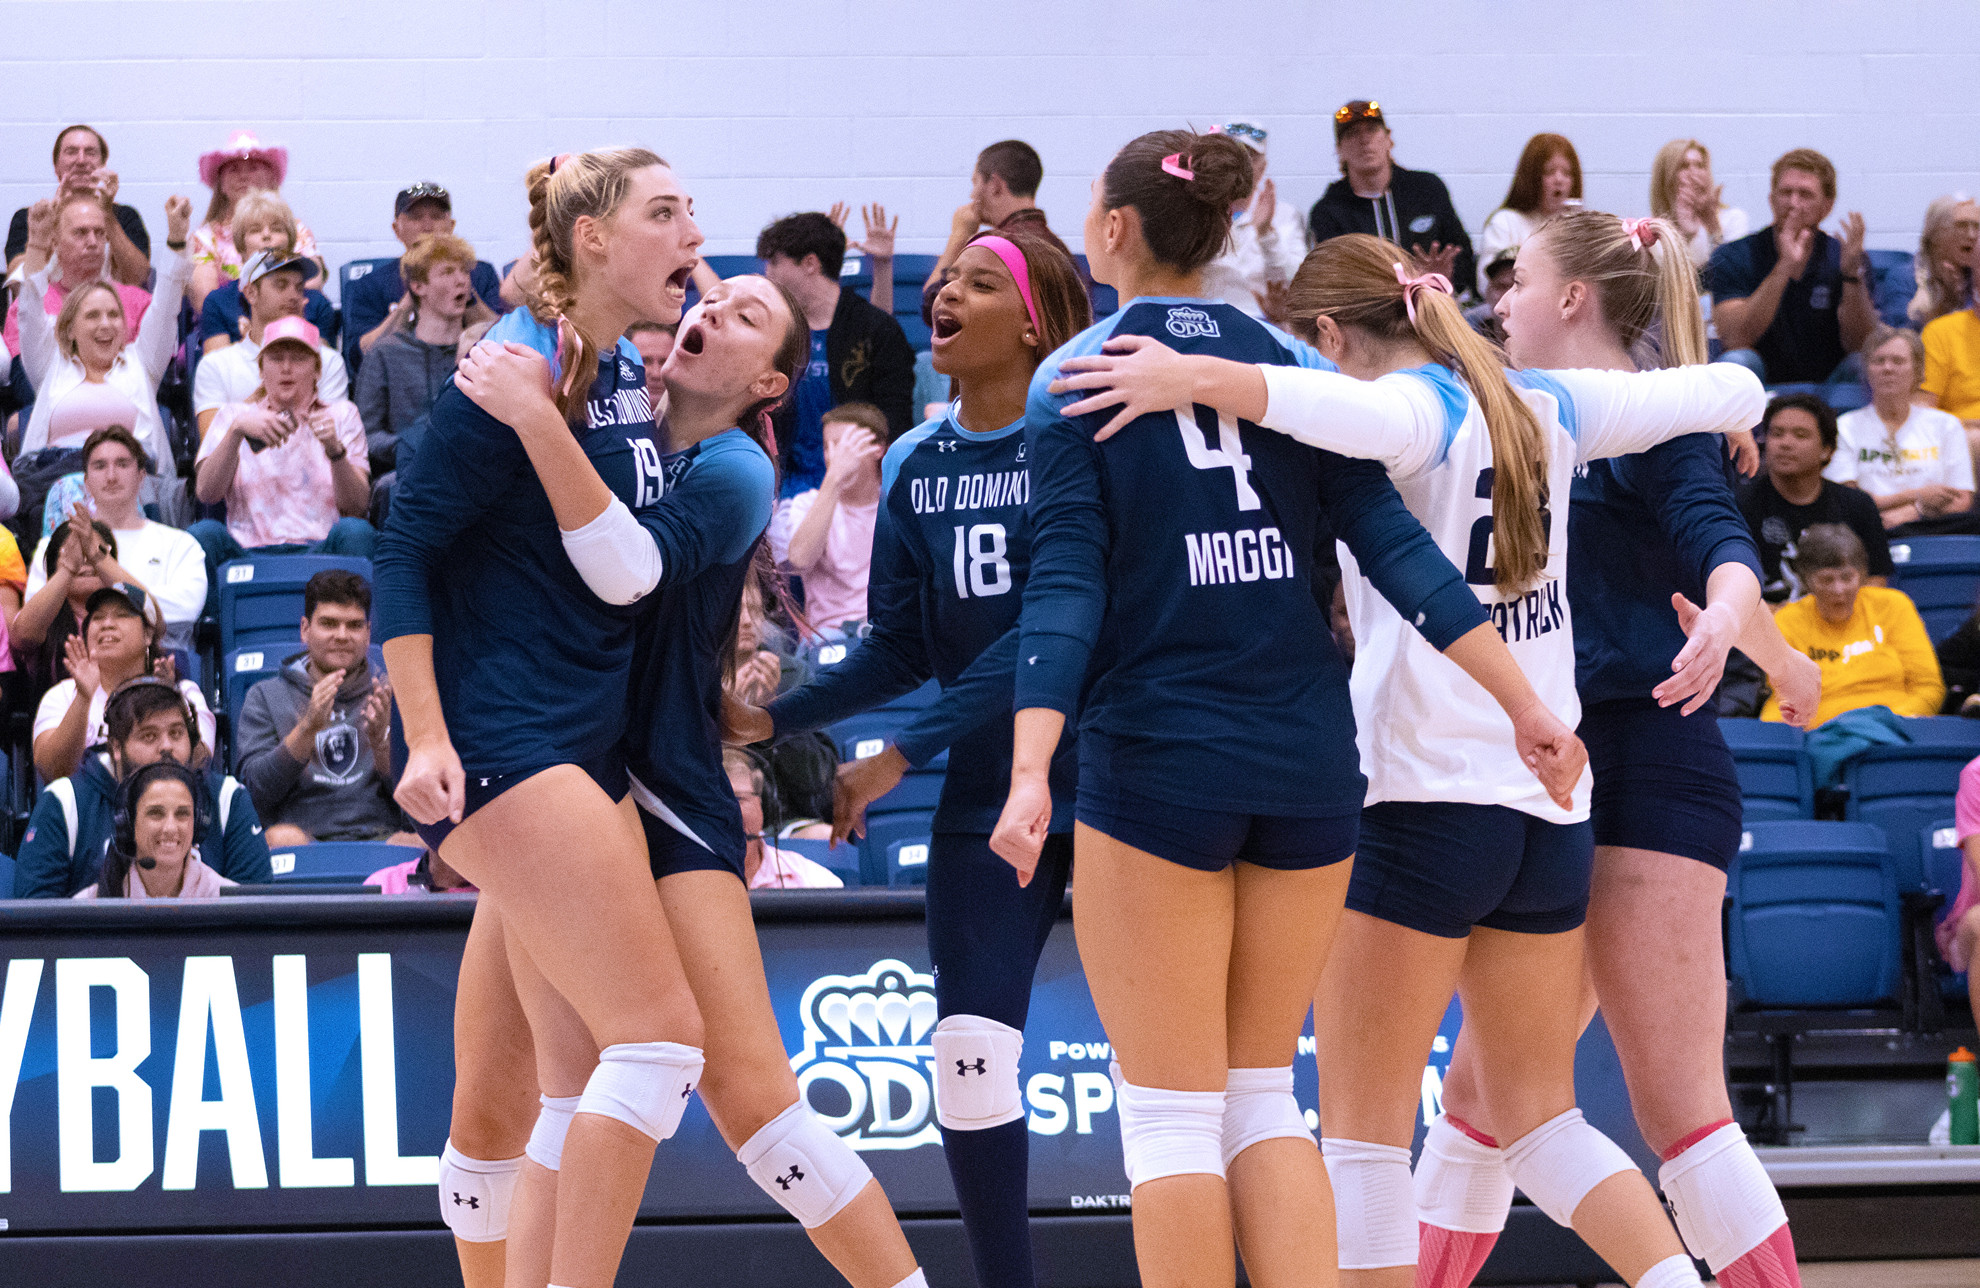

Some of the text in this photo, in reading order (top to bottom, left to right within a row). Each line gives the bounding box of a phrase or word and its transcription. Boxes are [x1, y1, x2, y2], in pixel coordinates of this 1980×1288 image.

[1167, 319, 1218, 337] ODU
[626, 437, 665, 509] 19
[1174, 400, 1262, 512] 4
[911, 477, 948, 515] OLD
[1465, 459, 1552, 586] 2
[953, 523, 1013, 600] 18
[1050, 1040, 1118, 1061] POW
[797, 1060, 940, 1134] OD
